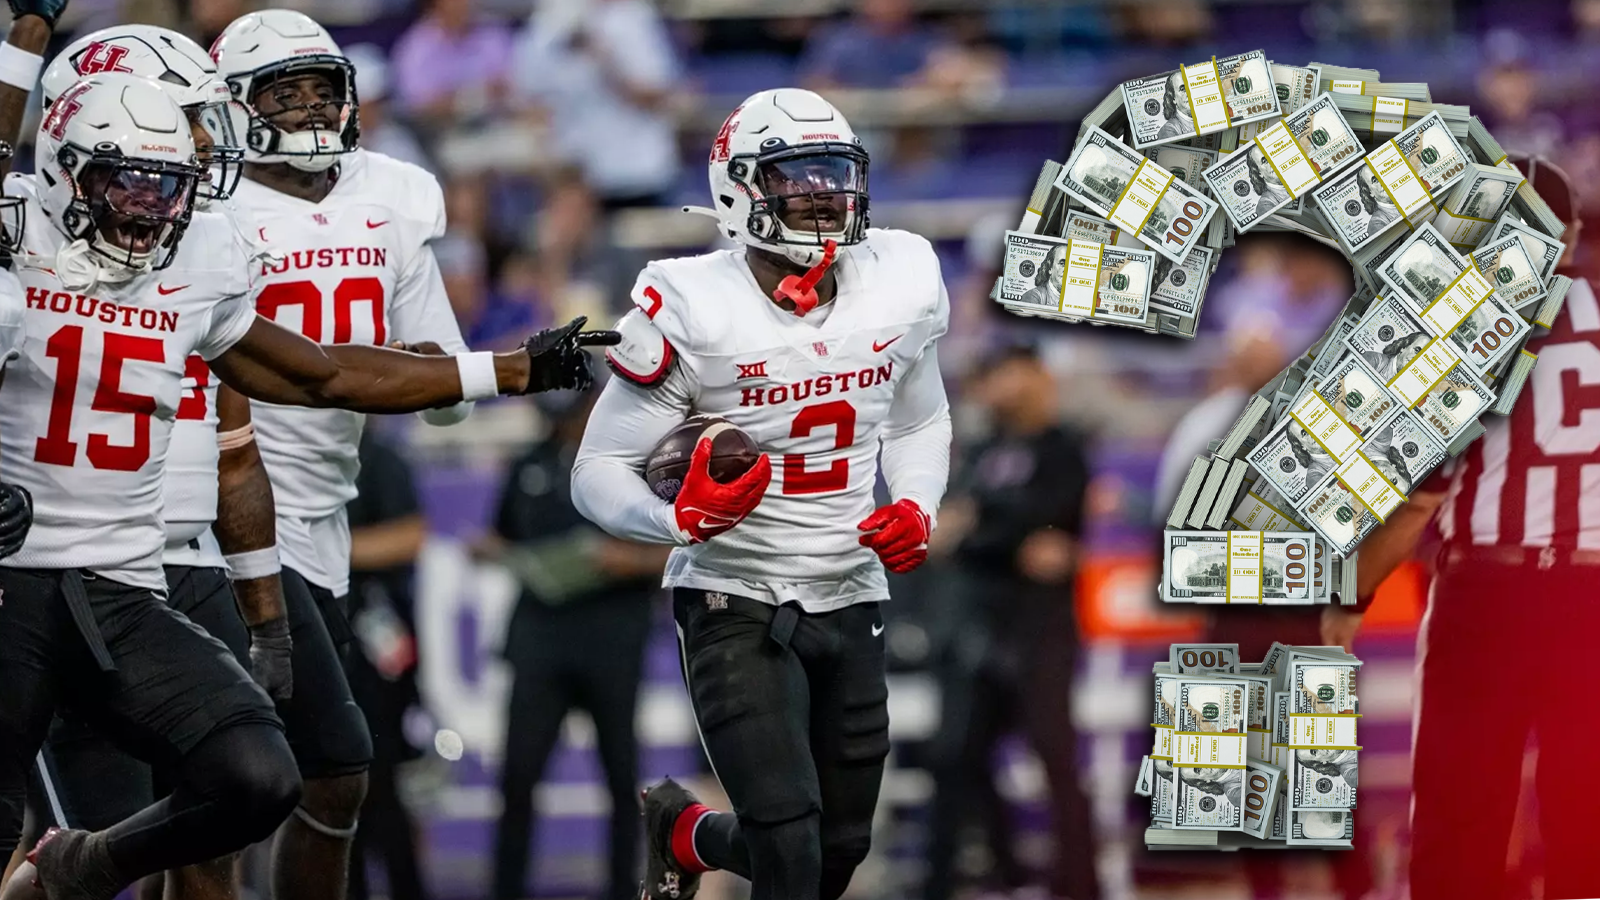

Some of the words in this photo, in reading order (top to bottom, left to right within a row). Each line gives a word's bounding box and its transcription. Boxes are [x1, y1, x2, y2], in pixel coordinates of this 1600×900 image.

[141, 144, 177, 153] HOUSTON
[802, 133, 840, 141] HOUSTON
[26, 287, 179, 332] HOUSTON
[736, 360, 769, 380] XII
[739, 361, 893, 407] HOUSTON
[34, 324, 166, 472] 15
[1531, 341, 1600, 455] C
[782, 399, 856, 495] 2
